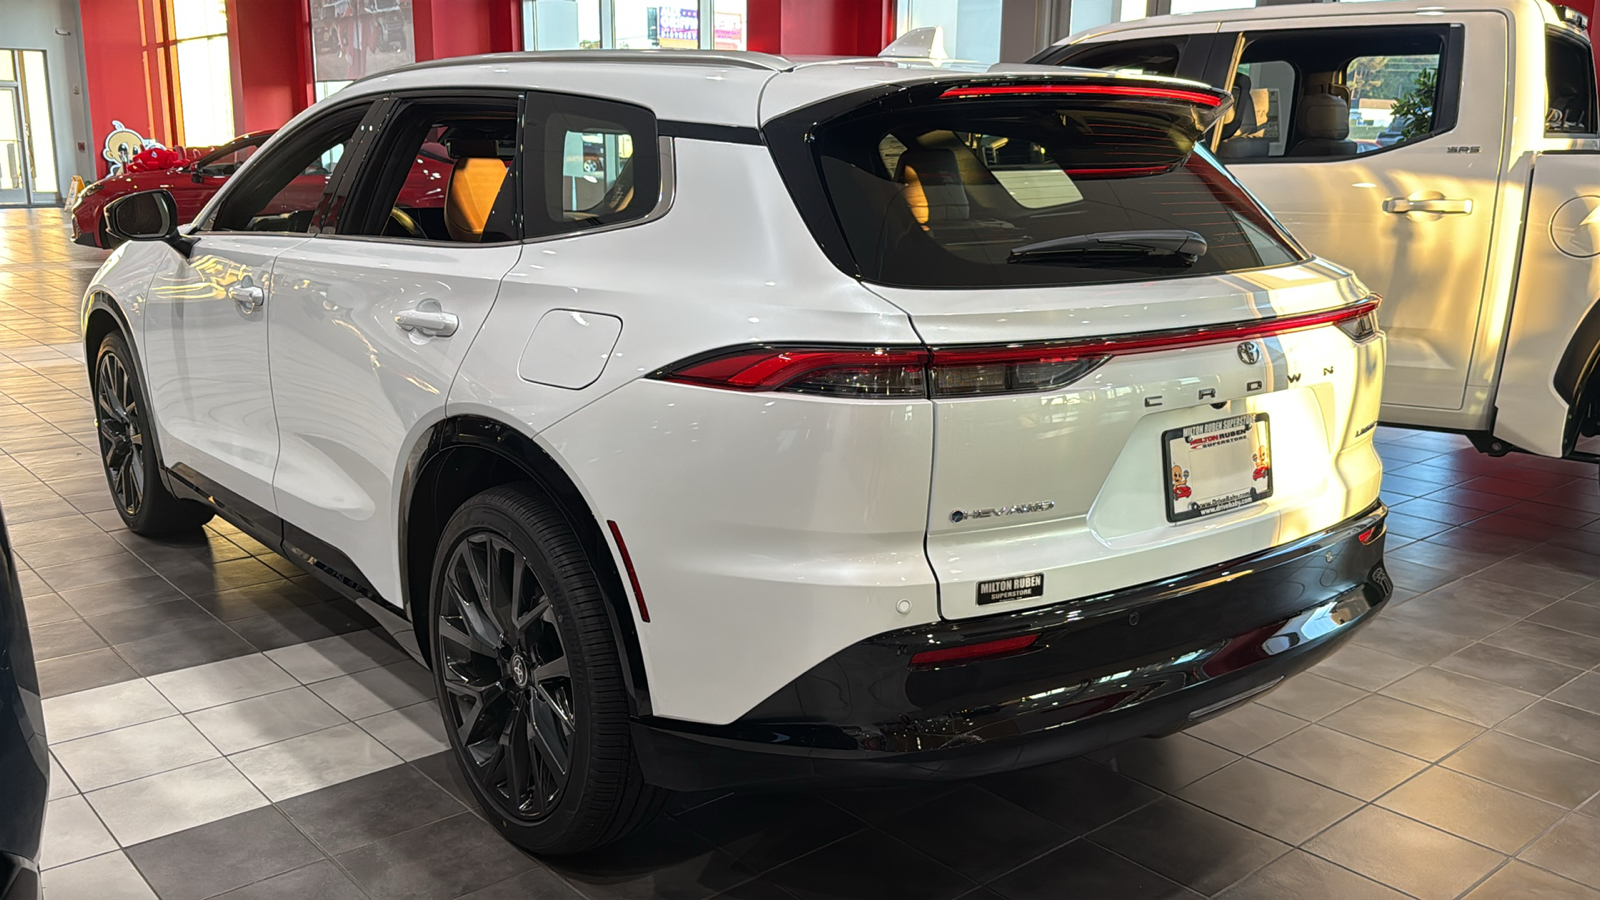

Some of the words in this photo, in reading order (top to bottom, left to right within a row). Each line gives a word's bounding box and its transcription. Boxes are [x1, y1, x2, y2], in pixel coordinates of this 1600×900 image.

[1144, 366, 1334, 408] CROWN
[1183, 424, 1204, 438] MILTON
[1204, 419, 1223, 433] RUBEN
[1190, 434, 1219, 446] MILTON
[1219, 429, 1246, 440] RUBEN
[1202, 435, 1247, 449] SUPERSTORE
[980, 580, 1013, 594] MILTON
[1013, 575, 1041, 590] RUBEN
[991, 588, 1032, 600] SUPERSTORE
